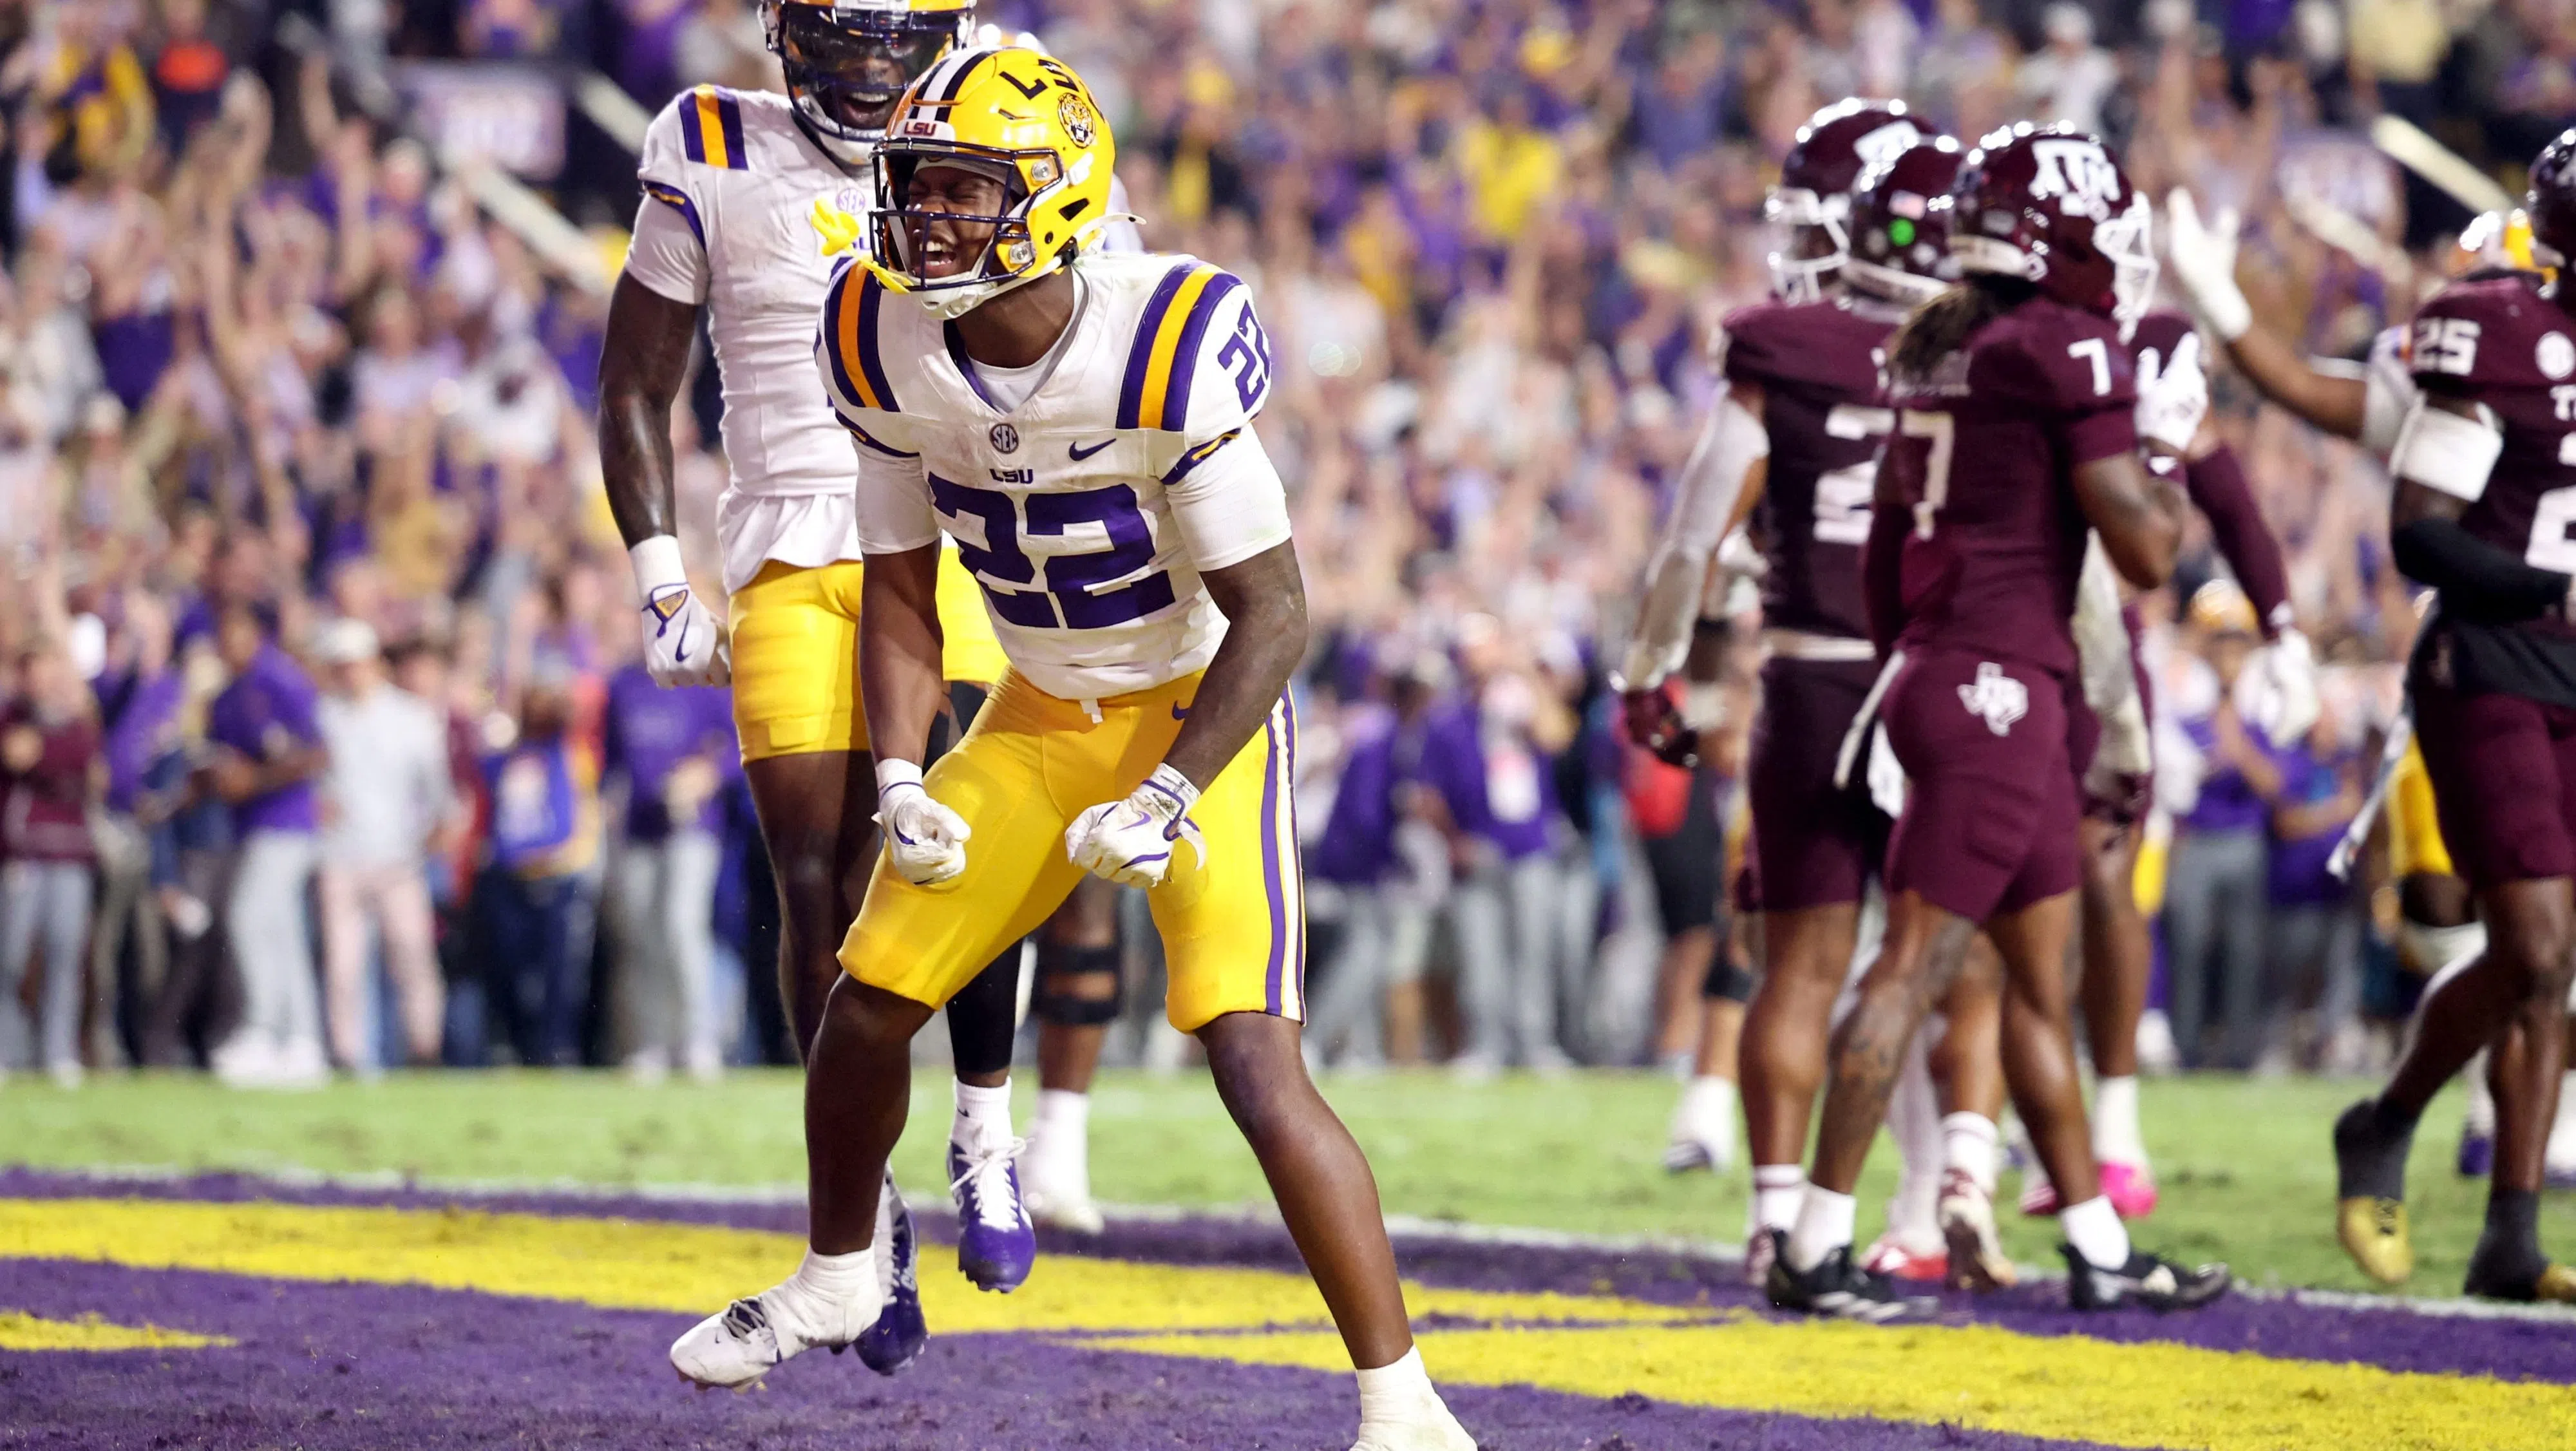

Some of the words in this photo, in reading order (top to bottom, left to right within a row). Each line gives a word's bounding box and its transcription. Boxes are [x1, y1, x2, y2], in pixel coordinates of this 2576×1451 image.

[998, 59, 1106, 124] LS
[904, 121, 936, 137] LSU
[1217, 299, 1271, 413] 22
[2067, 337, 2112, 397] 7
[990, 423, 1019, 454] SEC
[989, 468, 1034, 484] LSU
[1900, 407, 1955, 541] 7
[927, 471, 1175, 629] 22
